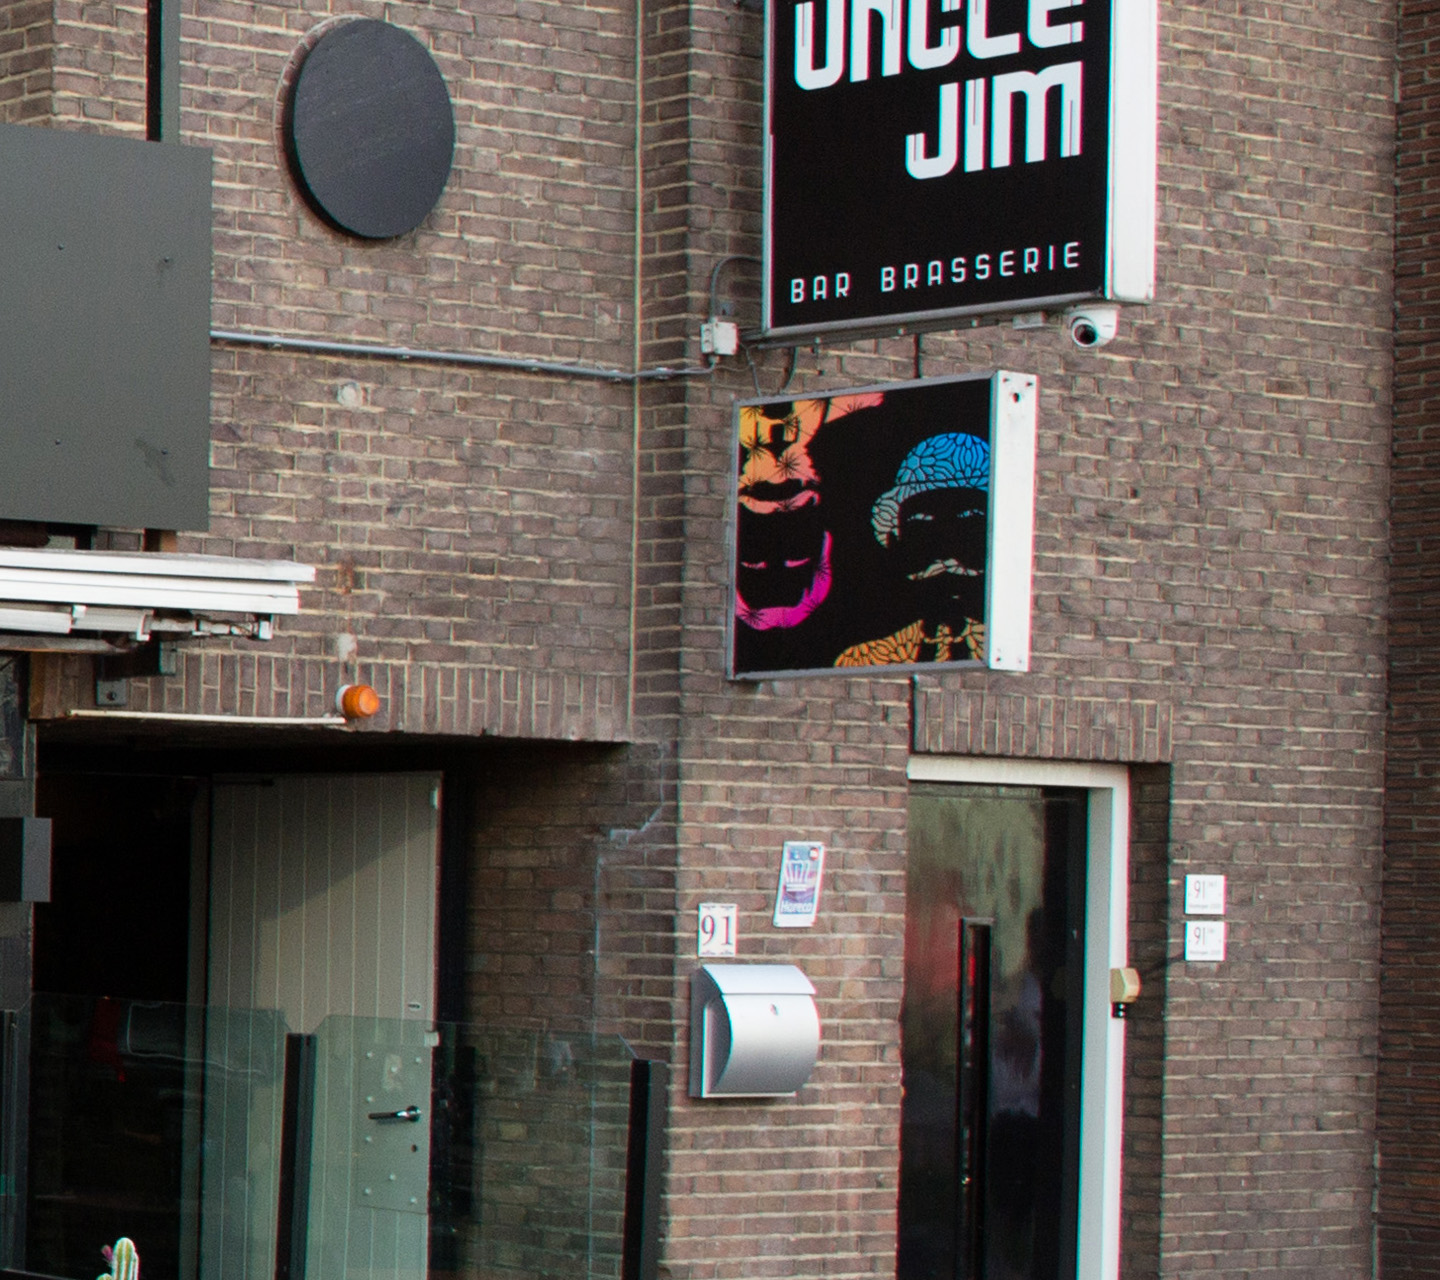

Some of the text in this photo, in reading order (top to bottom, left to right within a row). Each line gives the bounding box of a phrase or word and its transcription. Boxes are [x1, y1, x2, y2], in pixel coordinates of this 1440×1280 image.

[905, 60, 1085, 181] JIM
[790, 239, 1082, 304] BAR BRASSERIE
[701, 914, 733, 946] 91
